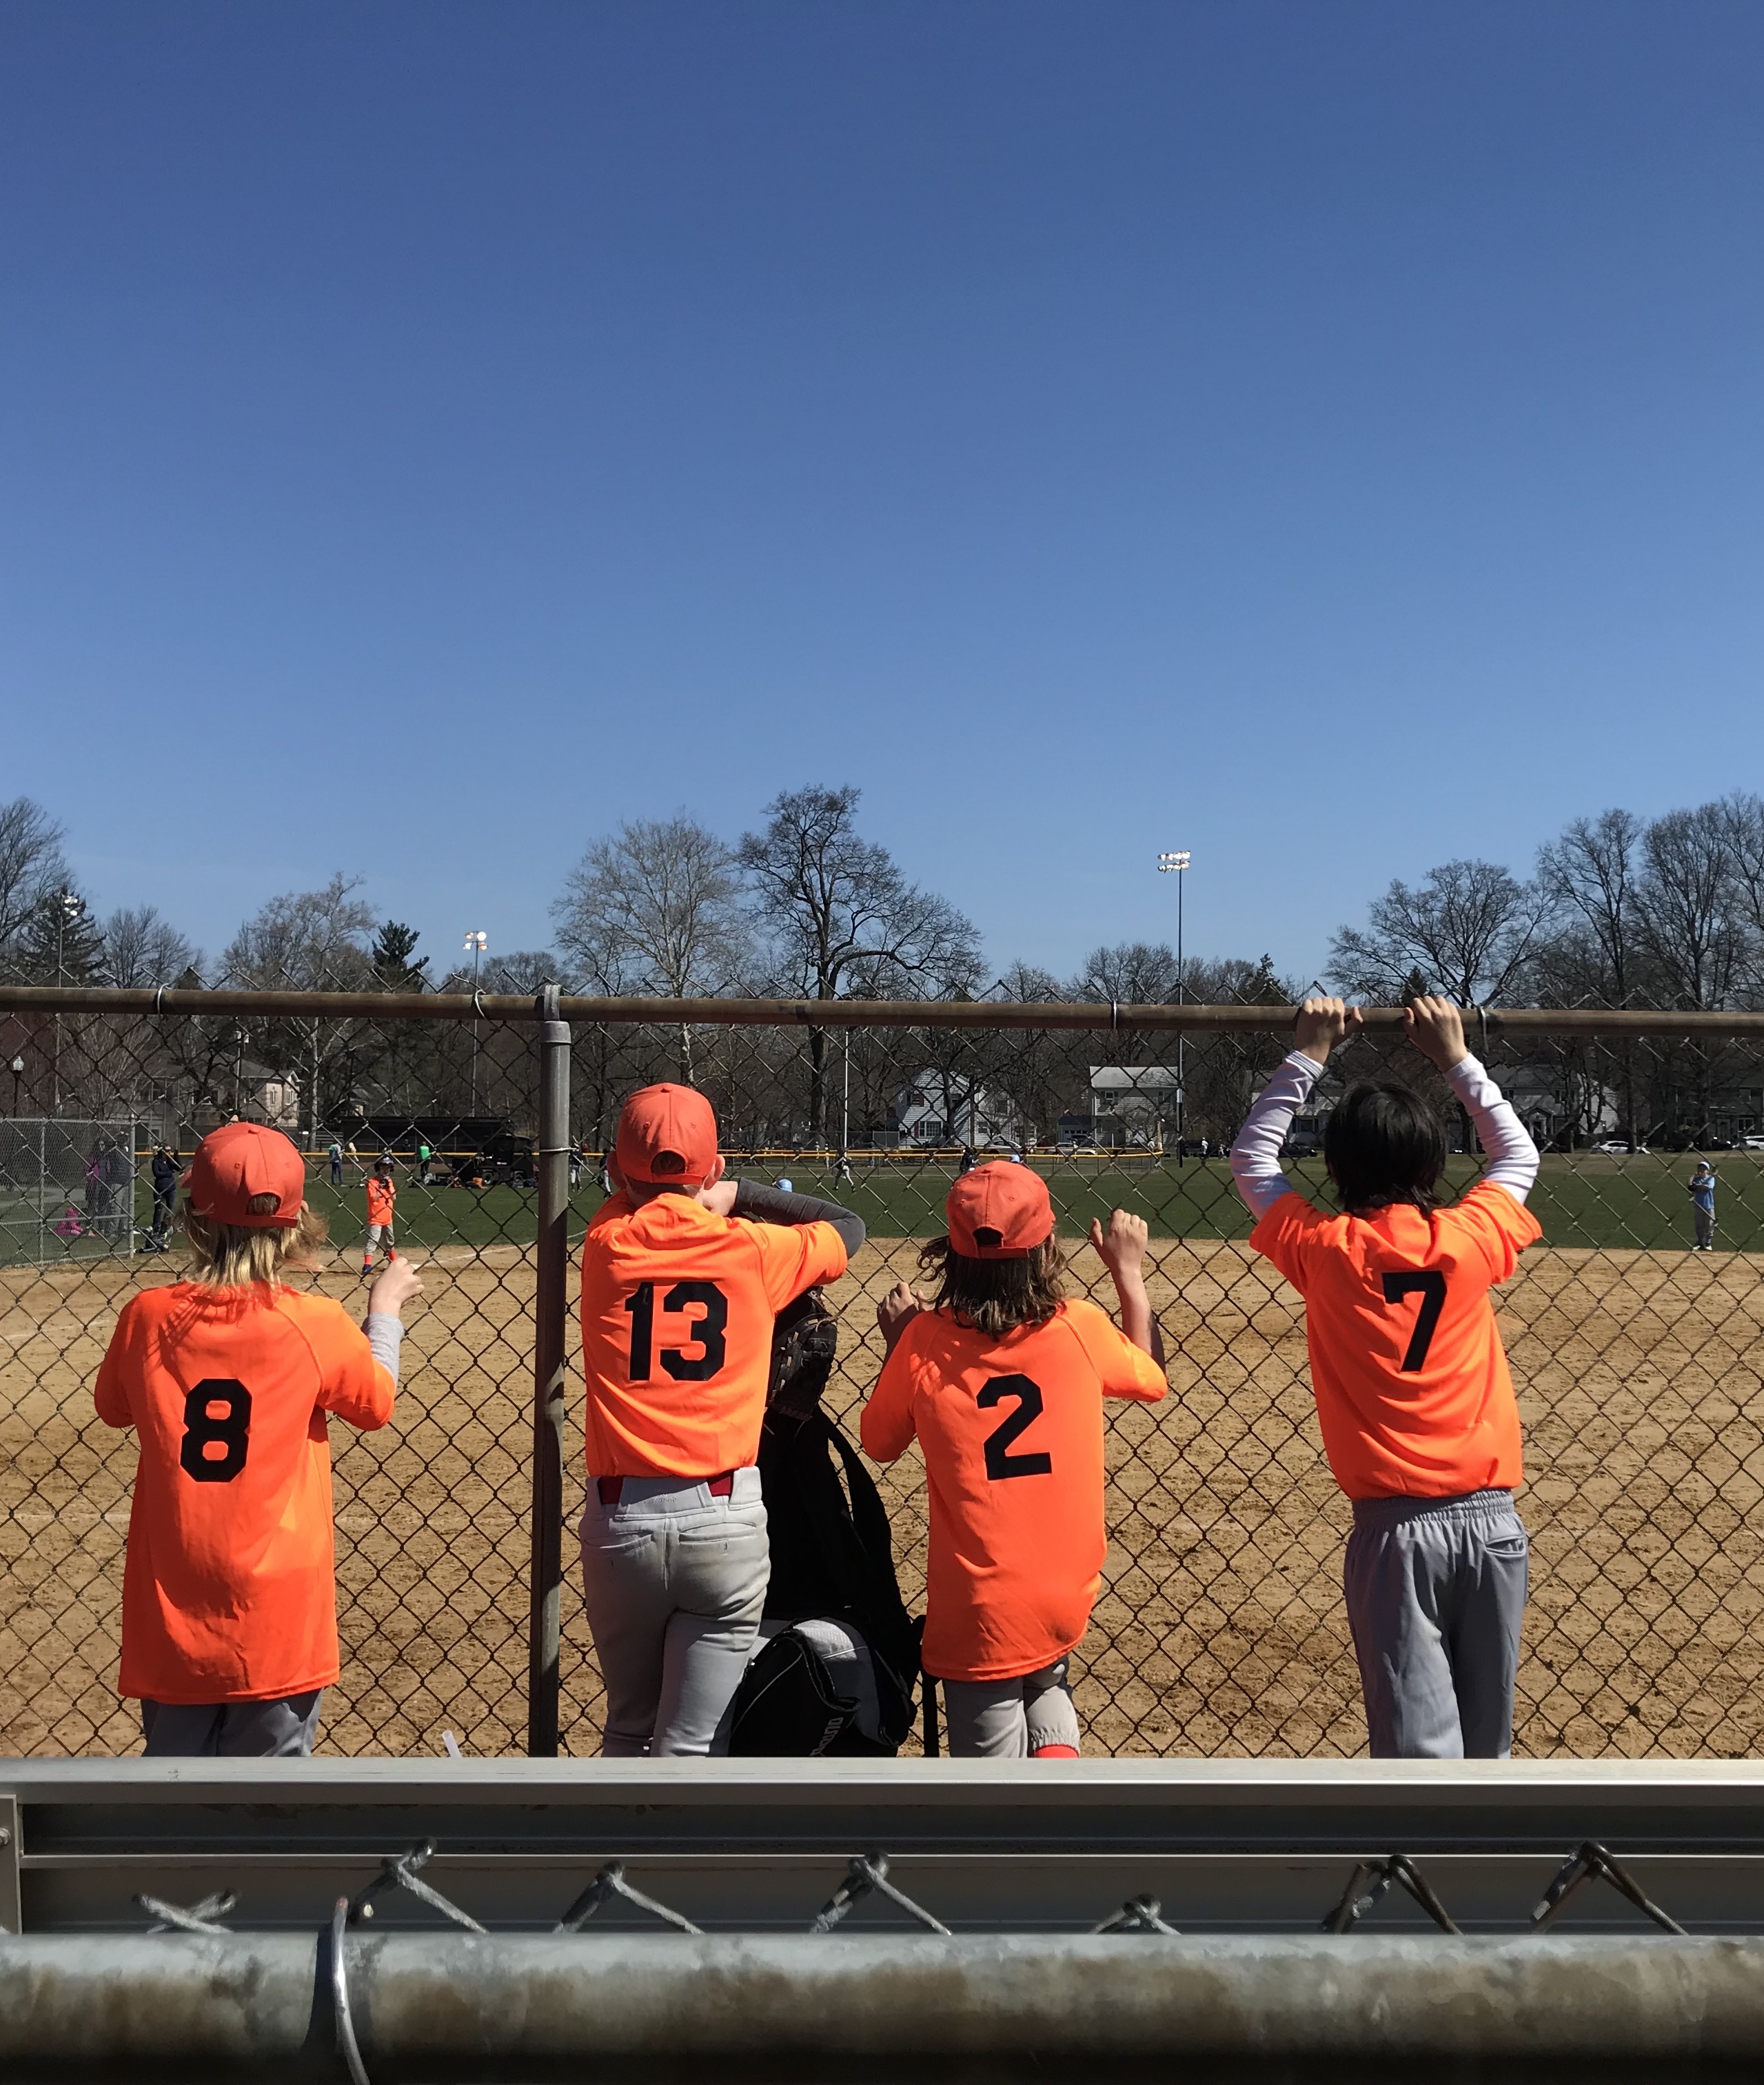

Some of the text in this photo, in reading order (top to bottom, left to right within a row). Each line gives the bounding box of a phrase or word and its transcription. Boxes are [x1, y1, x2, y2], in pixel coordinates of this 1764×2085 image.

[625, 1281, 728, 1381] 13
[1381, 1270, 1447, 1371] 7
[180, 1378, 252, 1482] 8
[976, 1373, 1052, 1480] 2
